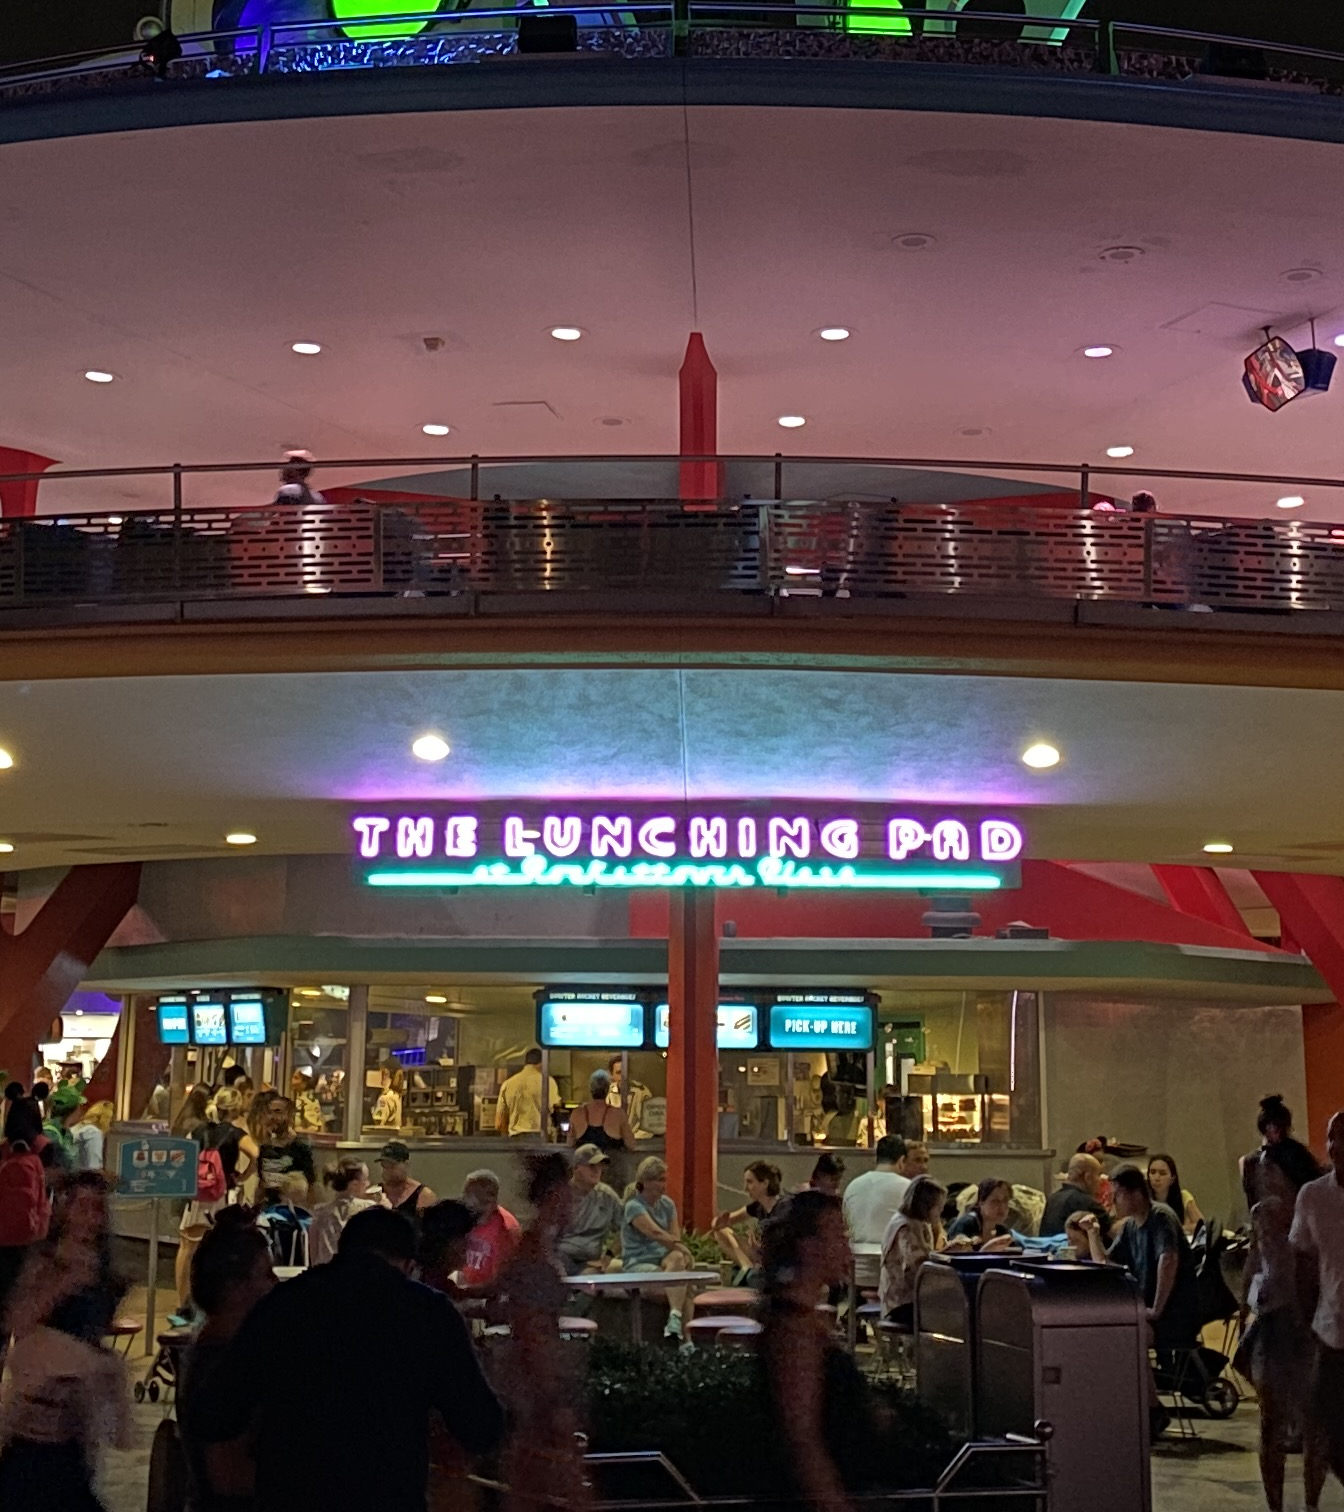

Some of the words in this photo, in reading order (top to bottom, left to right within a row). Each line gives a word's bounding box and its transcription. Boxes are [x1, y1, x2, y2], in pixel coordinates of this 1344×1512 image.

[353, 816, 479, 858] THE
[504, 815, 858, 860] LUNCHING
[888, 818, 1022, 861] PAD
[784, 1018, 828, 1034] PICK-UP
